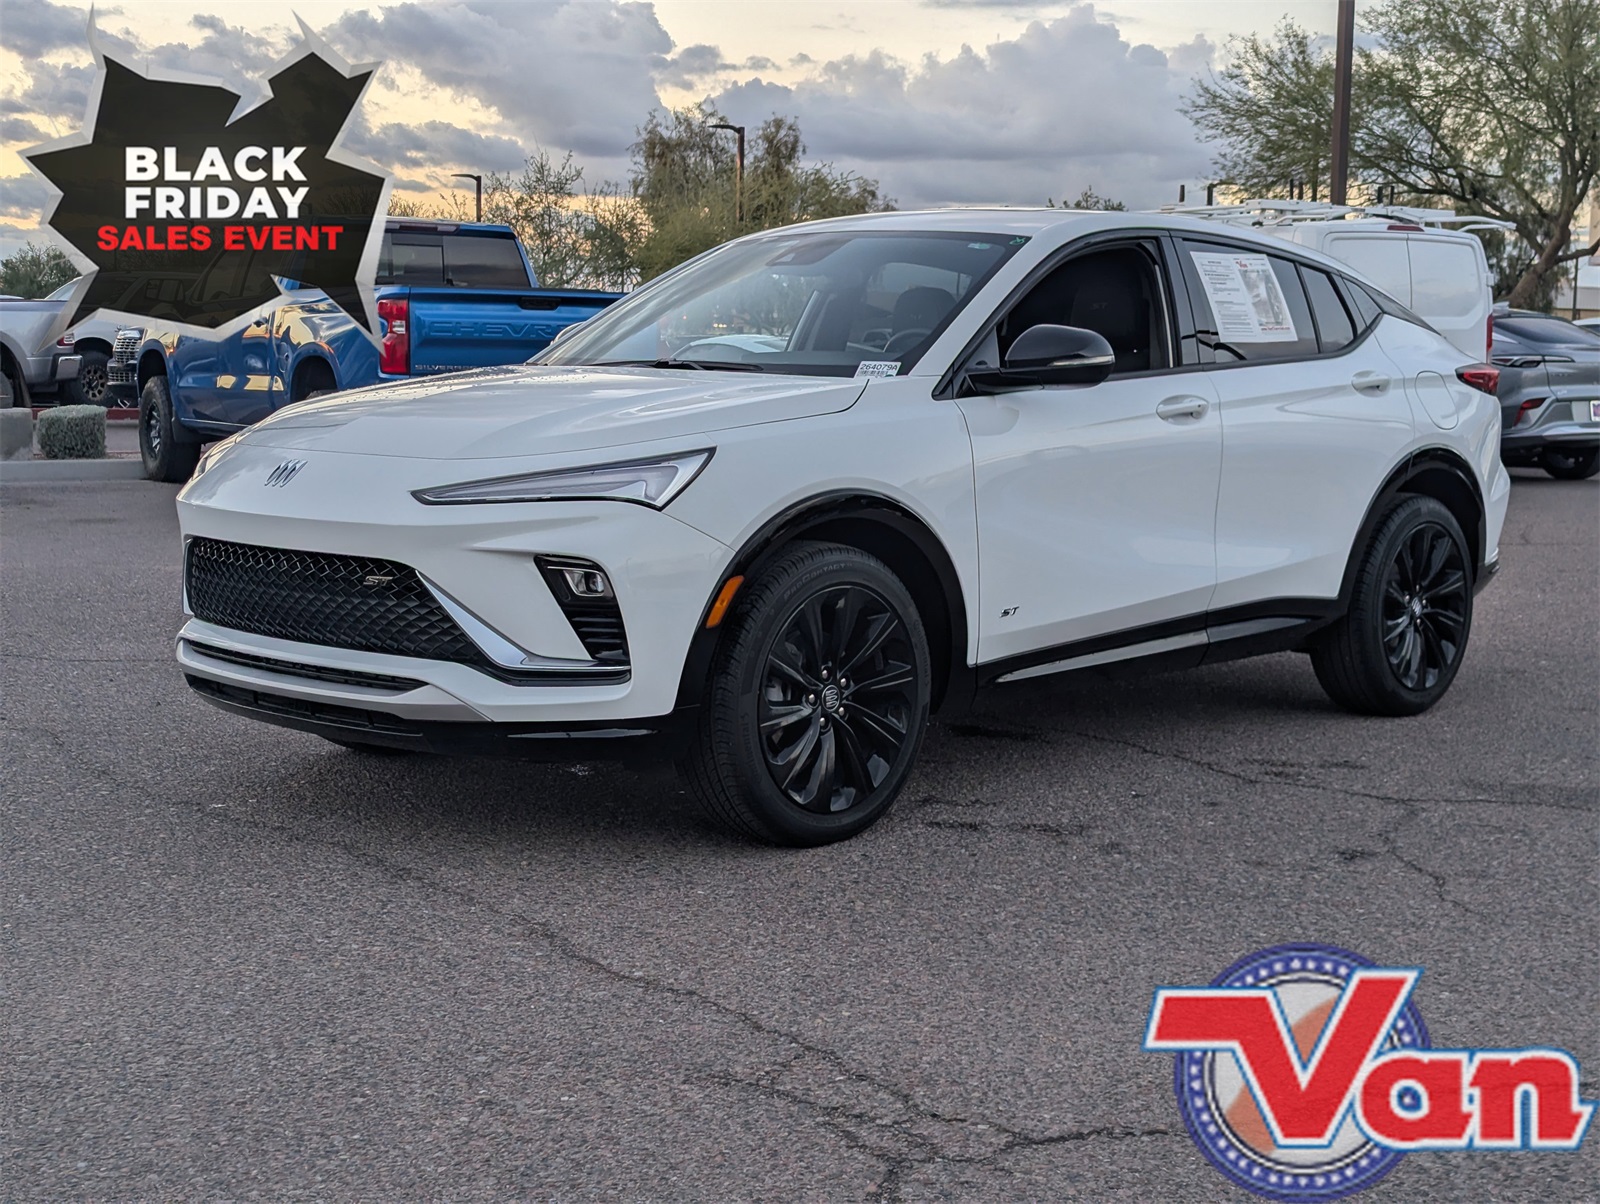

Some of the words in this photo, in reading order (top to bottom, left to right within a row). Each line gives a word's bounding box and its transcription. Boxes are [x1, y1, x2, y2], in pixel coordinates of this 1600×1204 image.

[430, 322, 568, 338] CHEVR
[860, 363, 898, 371] 264079A
[363, 576, 393, 586] ST
[999, 606, 1019, 618] ST
